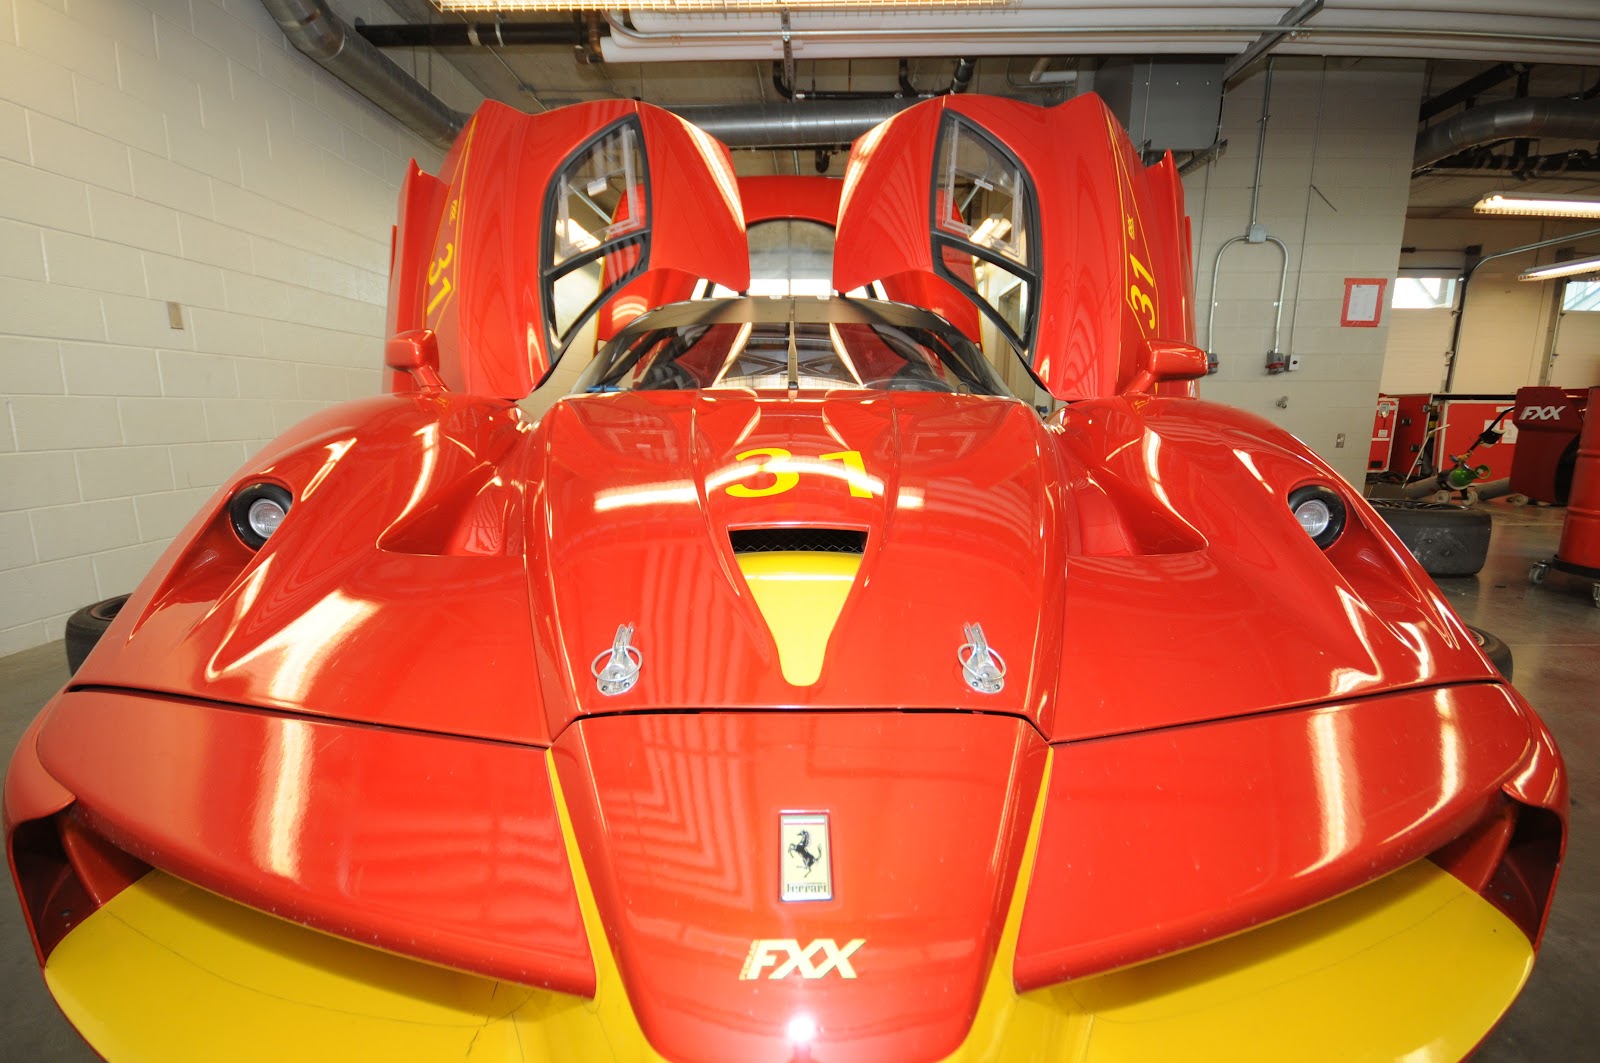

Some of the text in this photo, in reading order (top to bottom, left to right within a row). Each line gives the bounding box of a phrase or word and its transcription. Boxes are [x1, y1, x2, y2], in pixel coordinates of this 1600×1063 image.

[427, 242, 453, 316] 31
[1129, 252, 1156, 330] 31
[1520, 405, 1567, 420] FXX
[725, 447, 873, 498] 31
[743, 939, 867, 980] FXX
